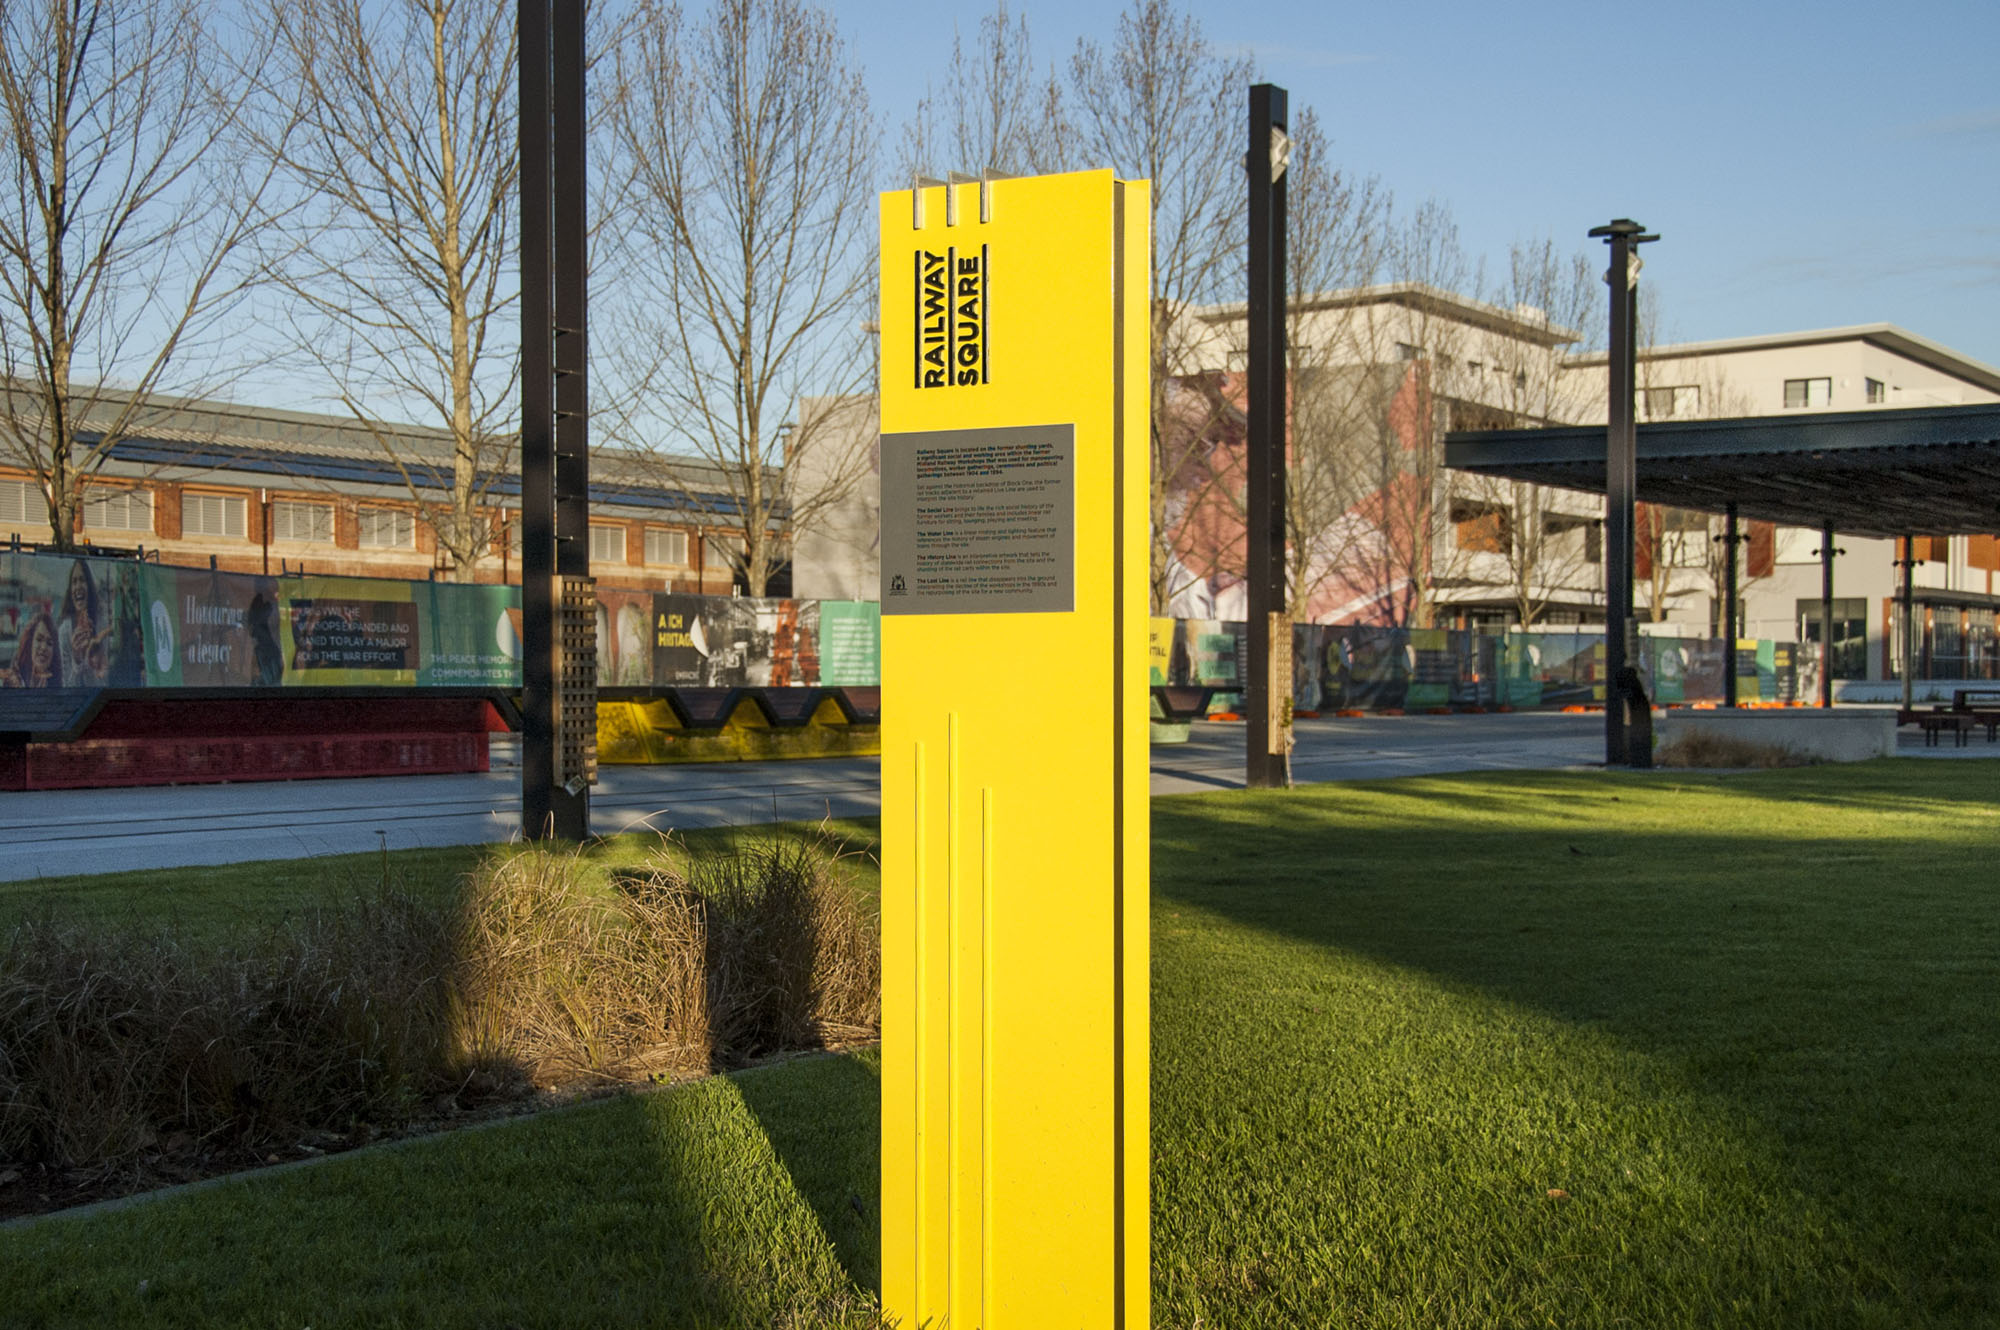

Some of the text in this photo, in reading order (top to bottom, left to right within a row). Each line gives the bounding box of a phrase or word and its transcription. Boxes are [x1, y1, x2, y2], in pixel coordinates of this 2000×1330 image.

[924, 251, 945, 388] RAILWAY
[957, 256, 979, 387] SQUARE
[342, 621, 388, 633] EXPANDED
[390, 623, 409, 634] AND
[329, 636, 343, 646] TO
[343, 636, 364, 646] PLAY
[367, 637, 375, 647] A
[375, 638, 407, 648] MAJOR
[321, 651, 340, 661] THE
[342, 651, 361, 661] WAR
[431, 668, 502, 678] COMMEMORATES
